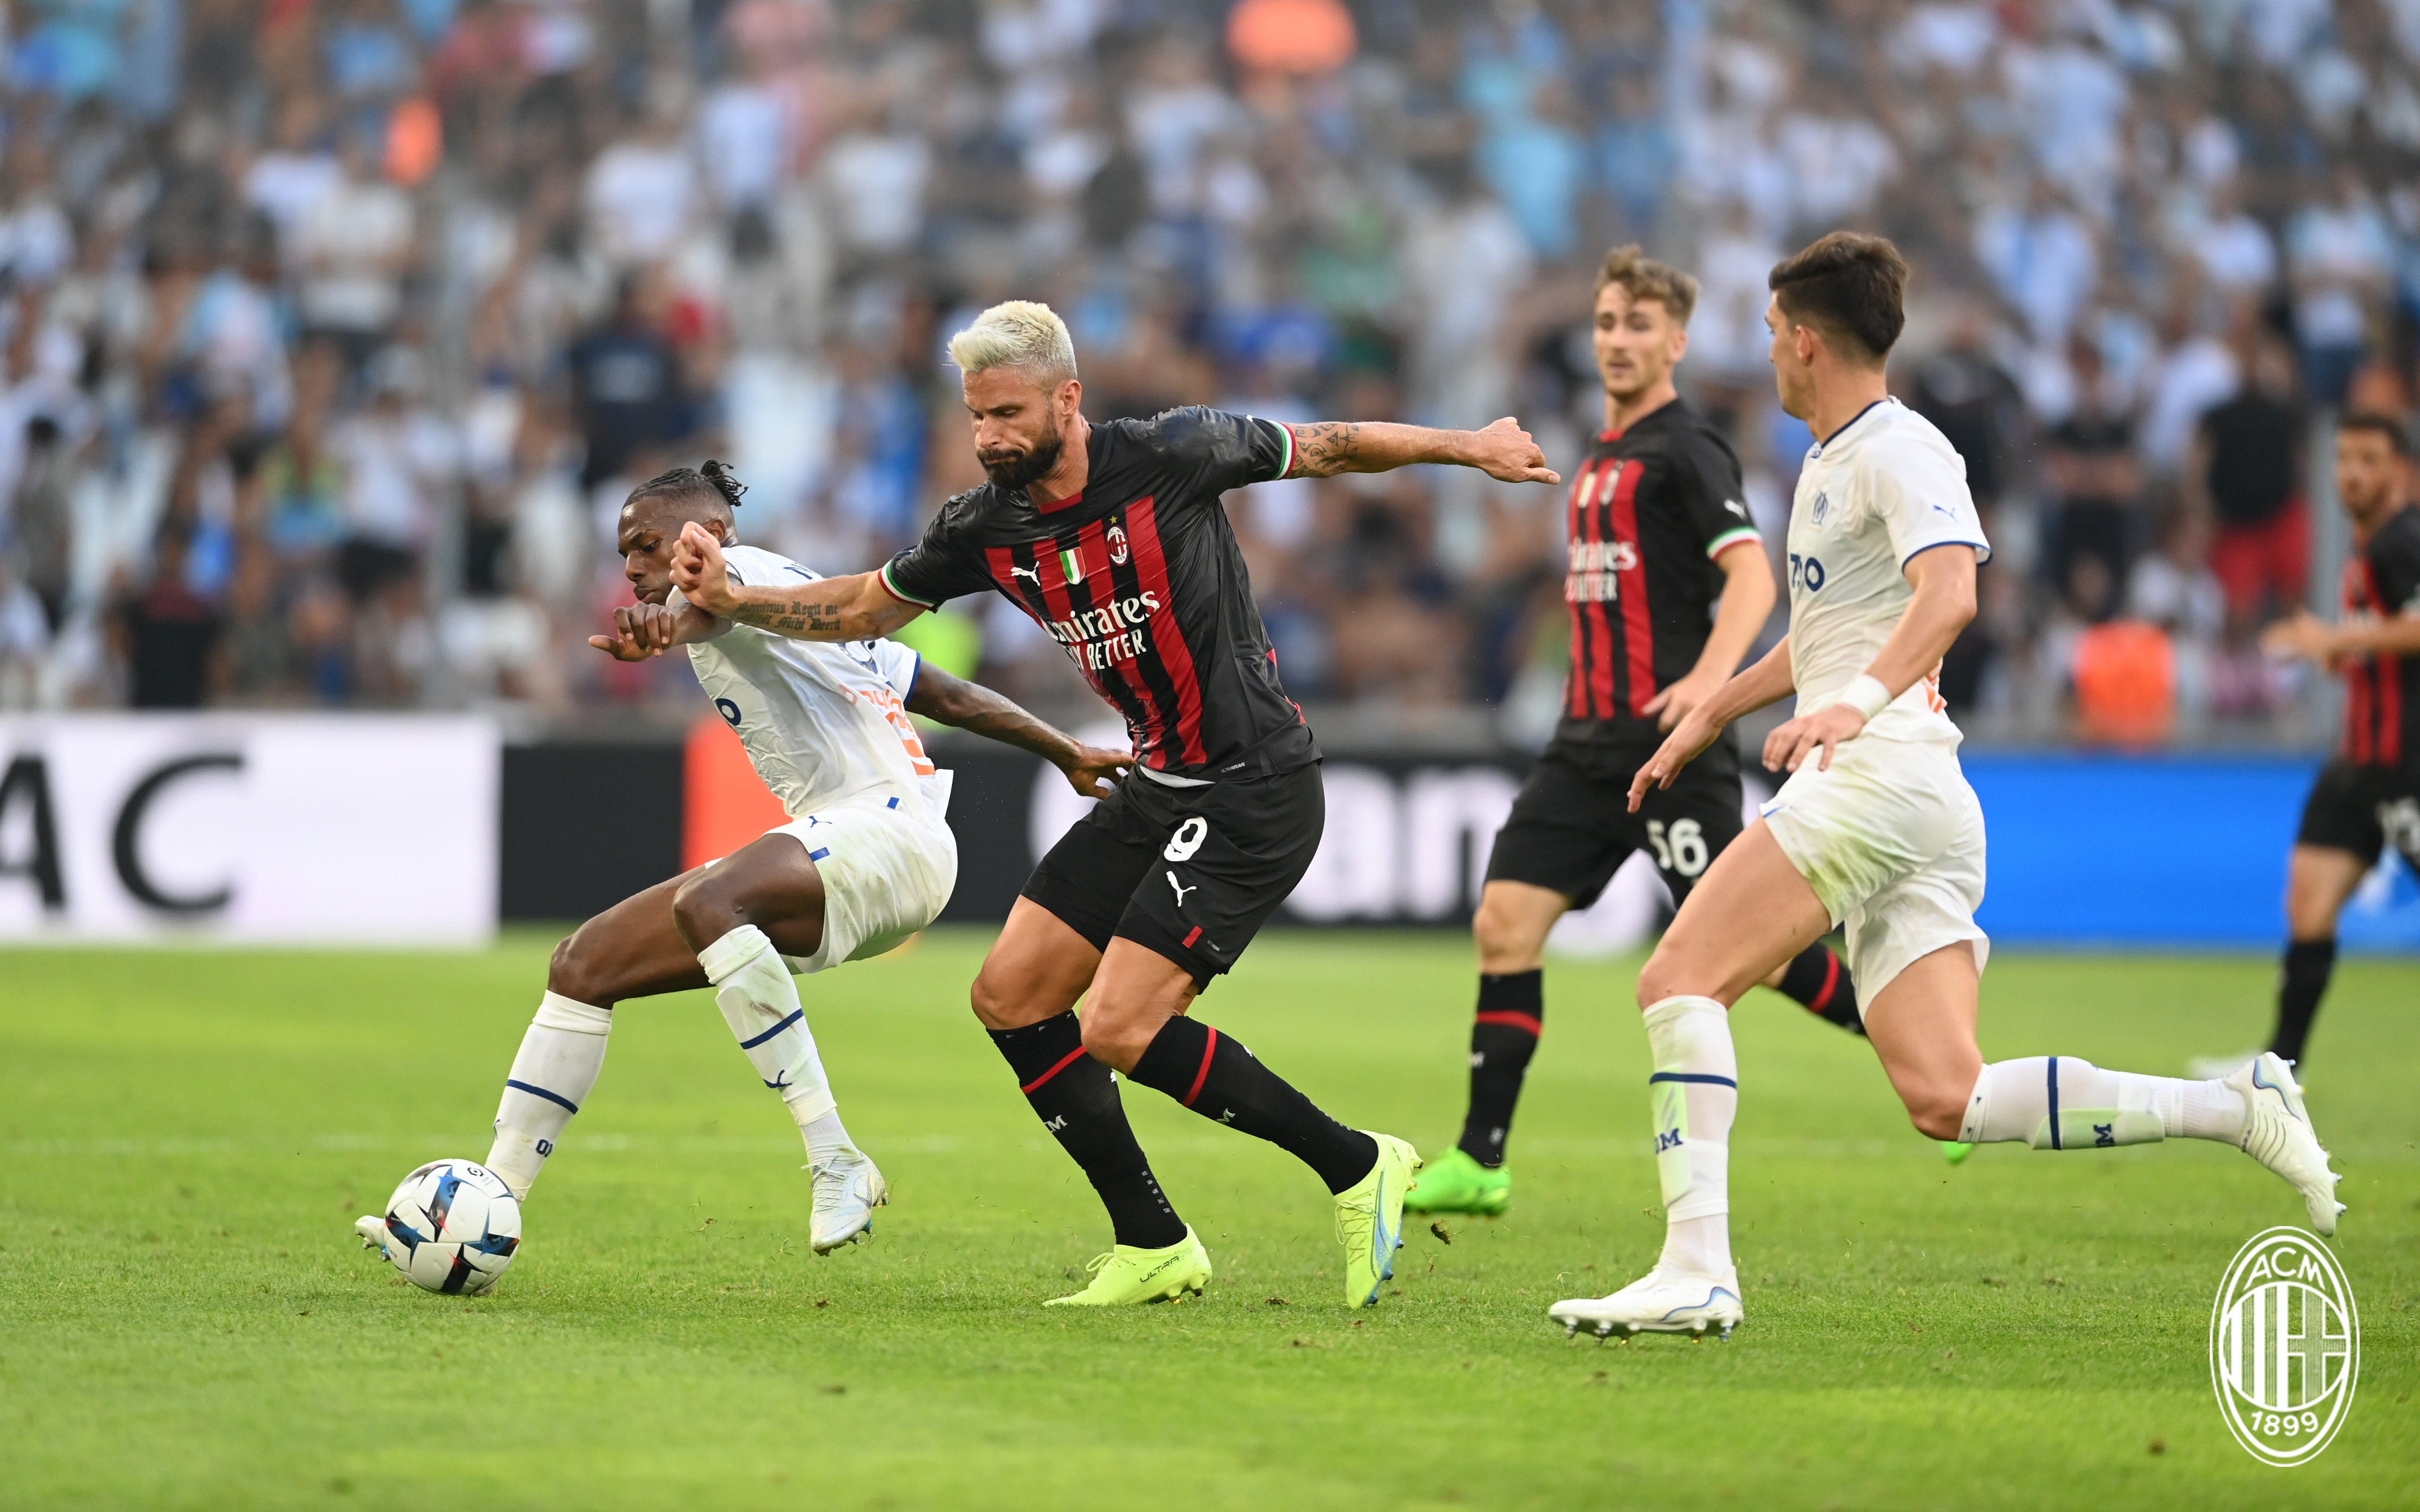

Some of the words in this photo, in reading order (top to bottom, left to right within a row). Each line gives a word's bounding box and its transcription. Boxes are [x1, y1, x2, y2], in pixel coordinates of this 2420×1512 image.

[1087, 629, 1147, 670] BETTER
[1164, 816, 1207, 862] 9
[1646, 818, 1709, 877] 56
